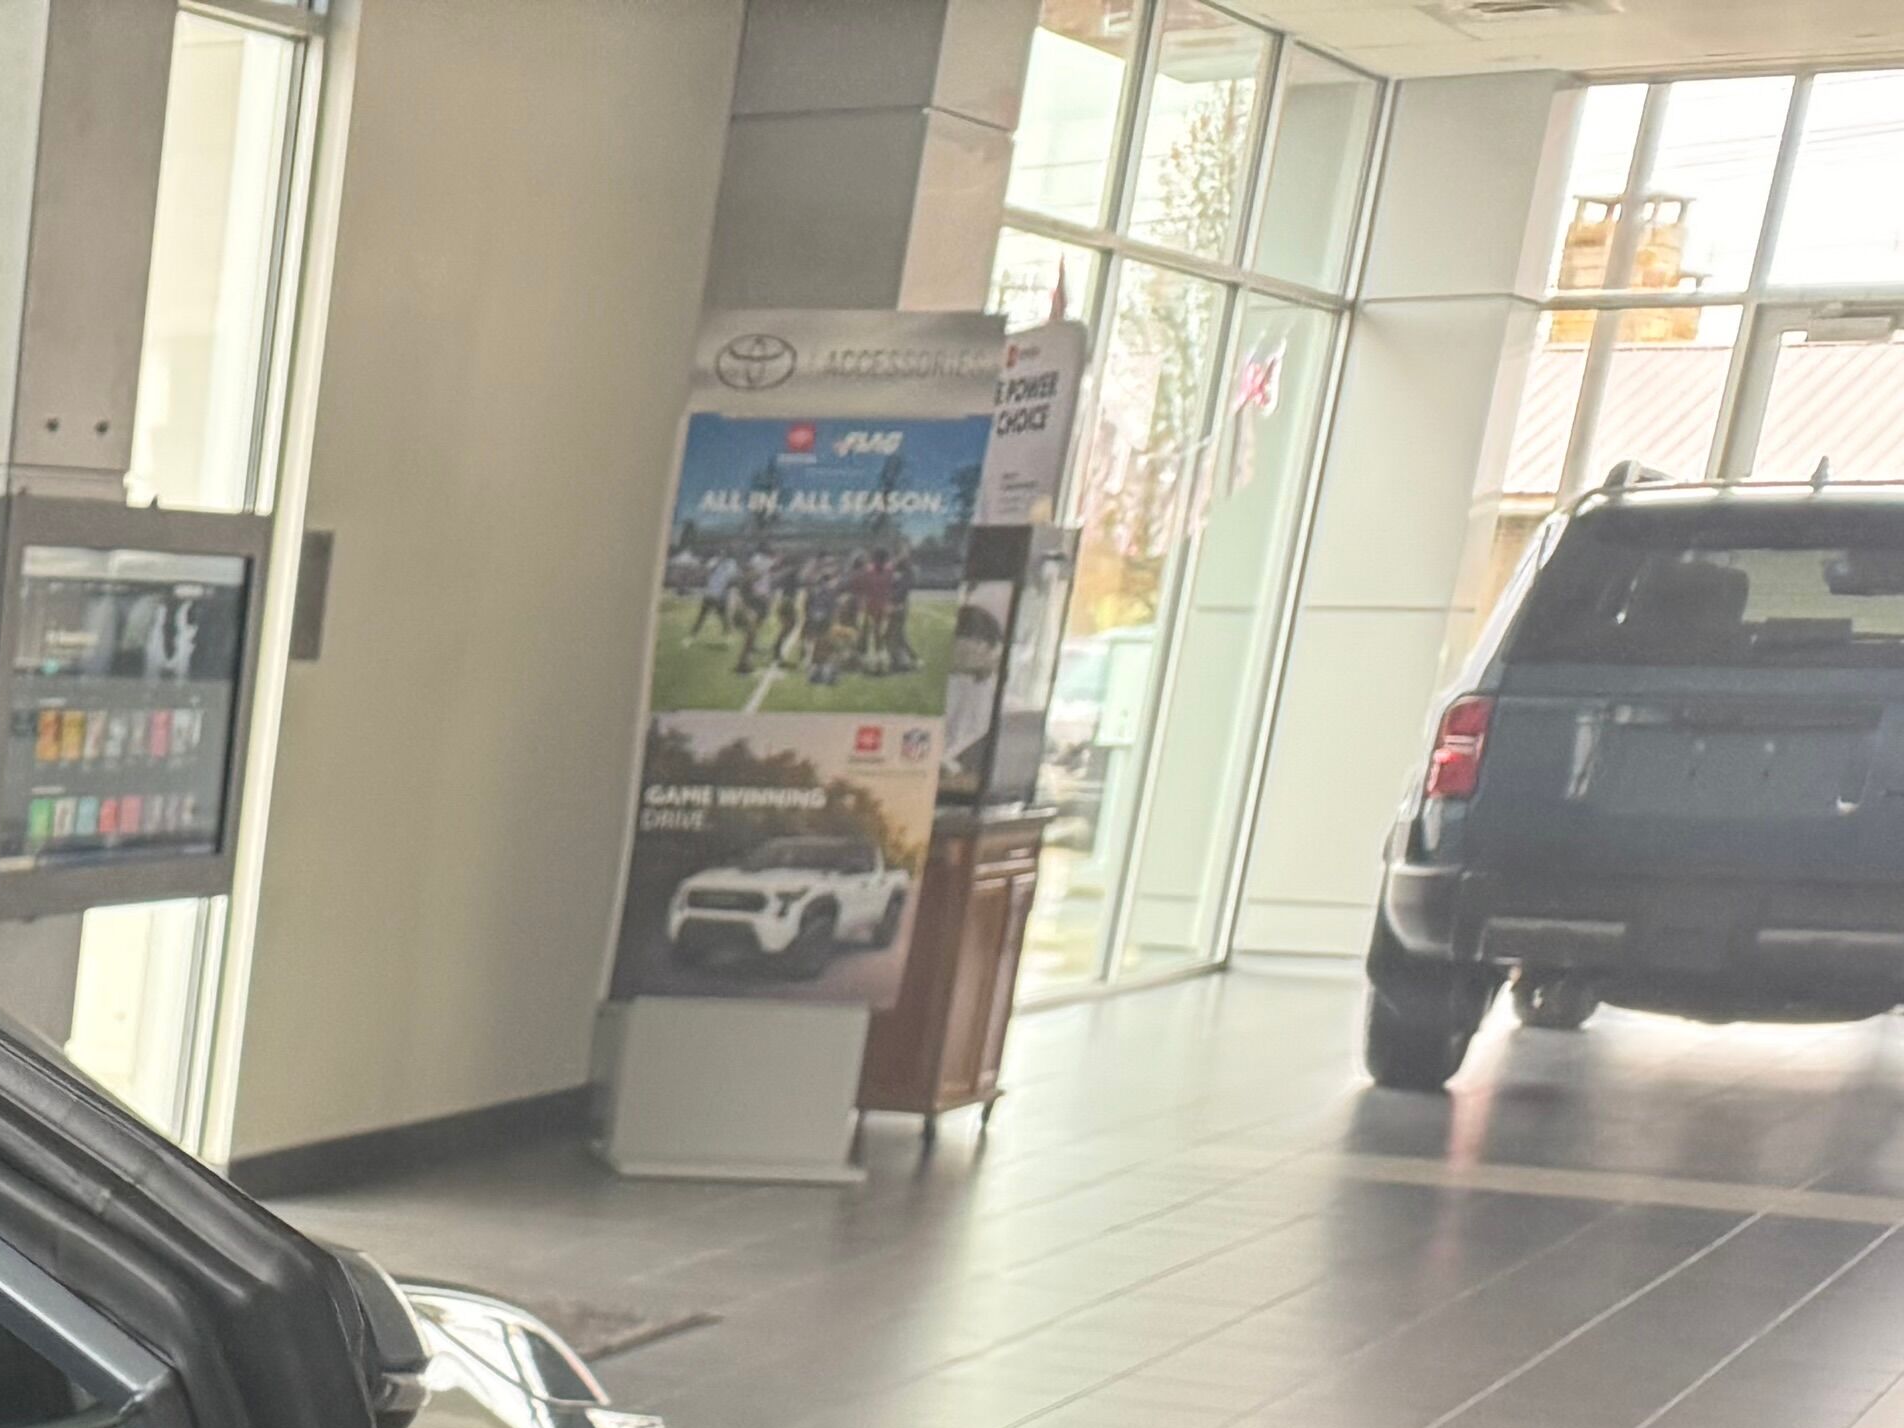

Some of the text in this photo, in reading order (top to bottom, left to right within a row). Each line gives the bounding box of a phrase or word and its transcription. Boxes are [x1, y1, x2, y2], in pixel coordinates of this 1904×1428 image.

[1007, 371, 1059, 402] POWER
[996, 403, 1051, 436] CHOICE
[700, 488, 742, 514] ALL
[788, 488, 833, 514] ALL
[644, 785, 827, 809] GAME WINNING
